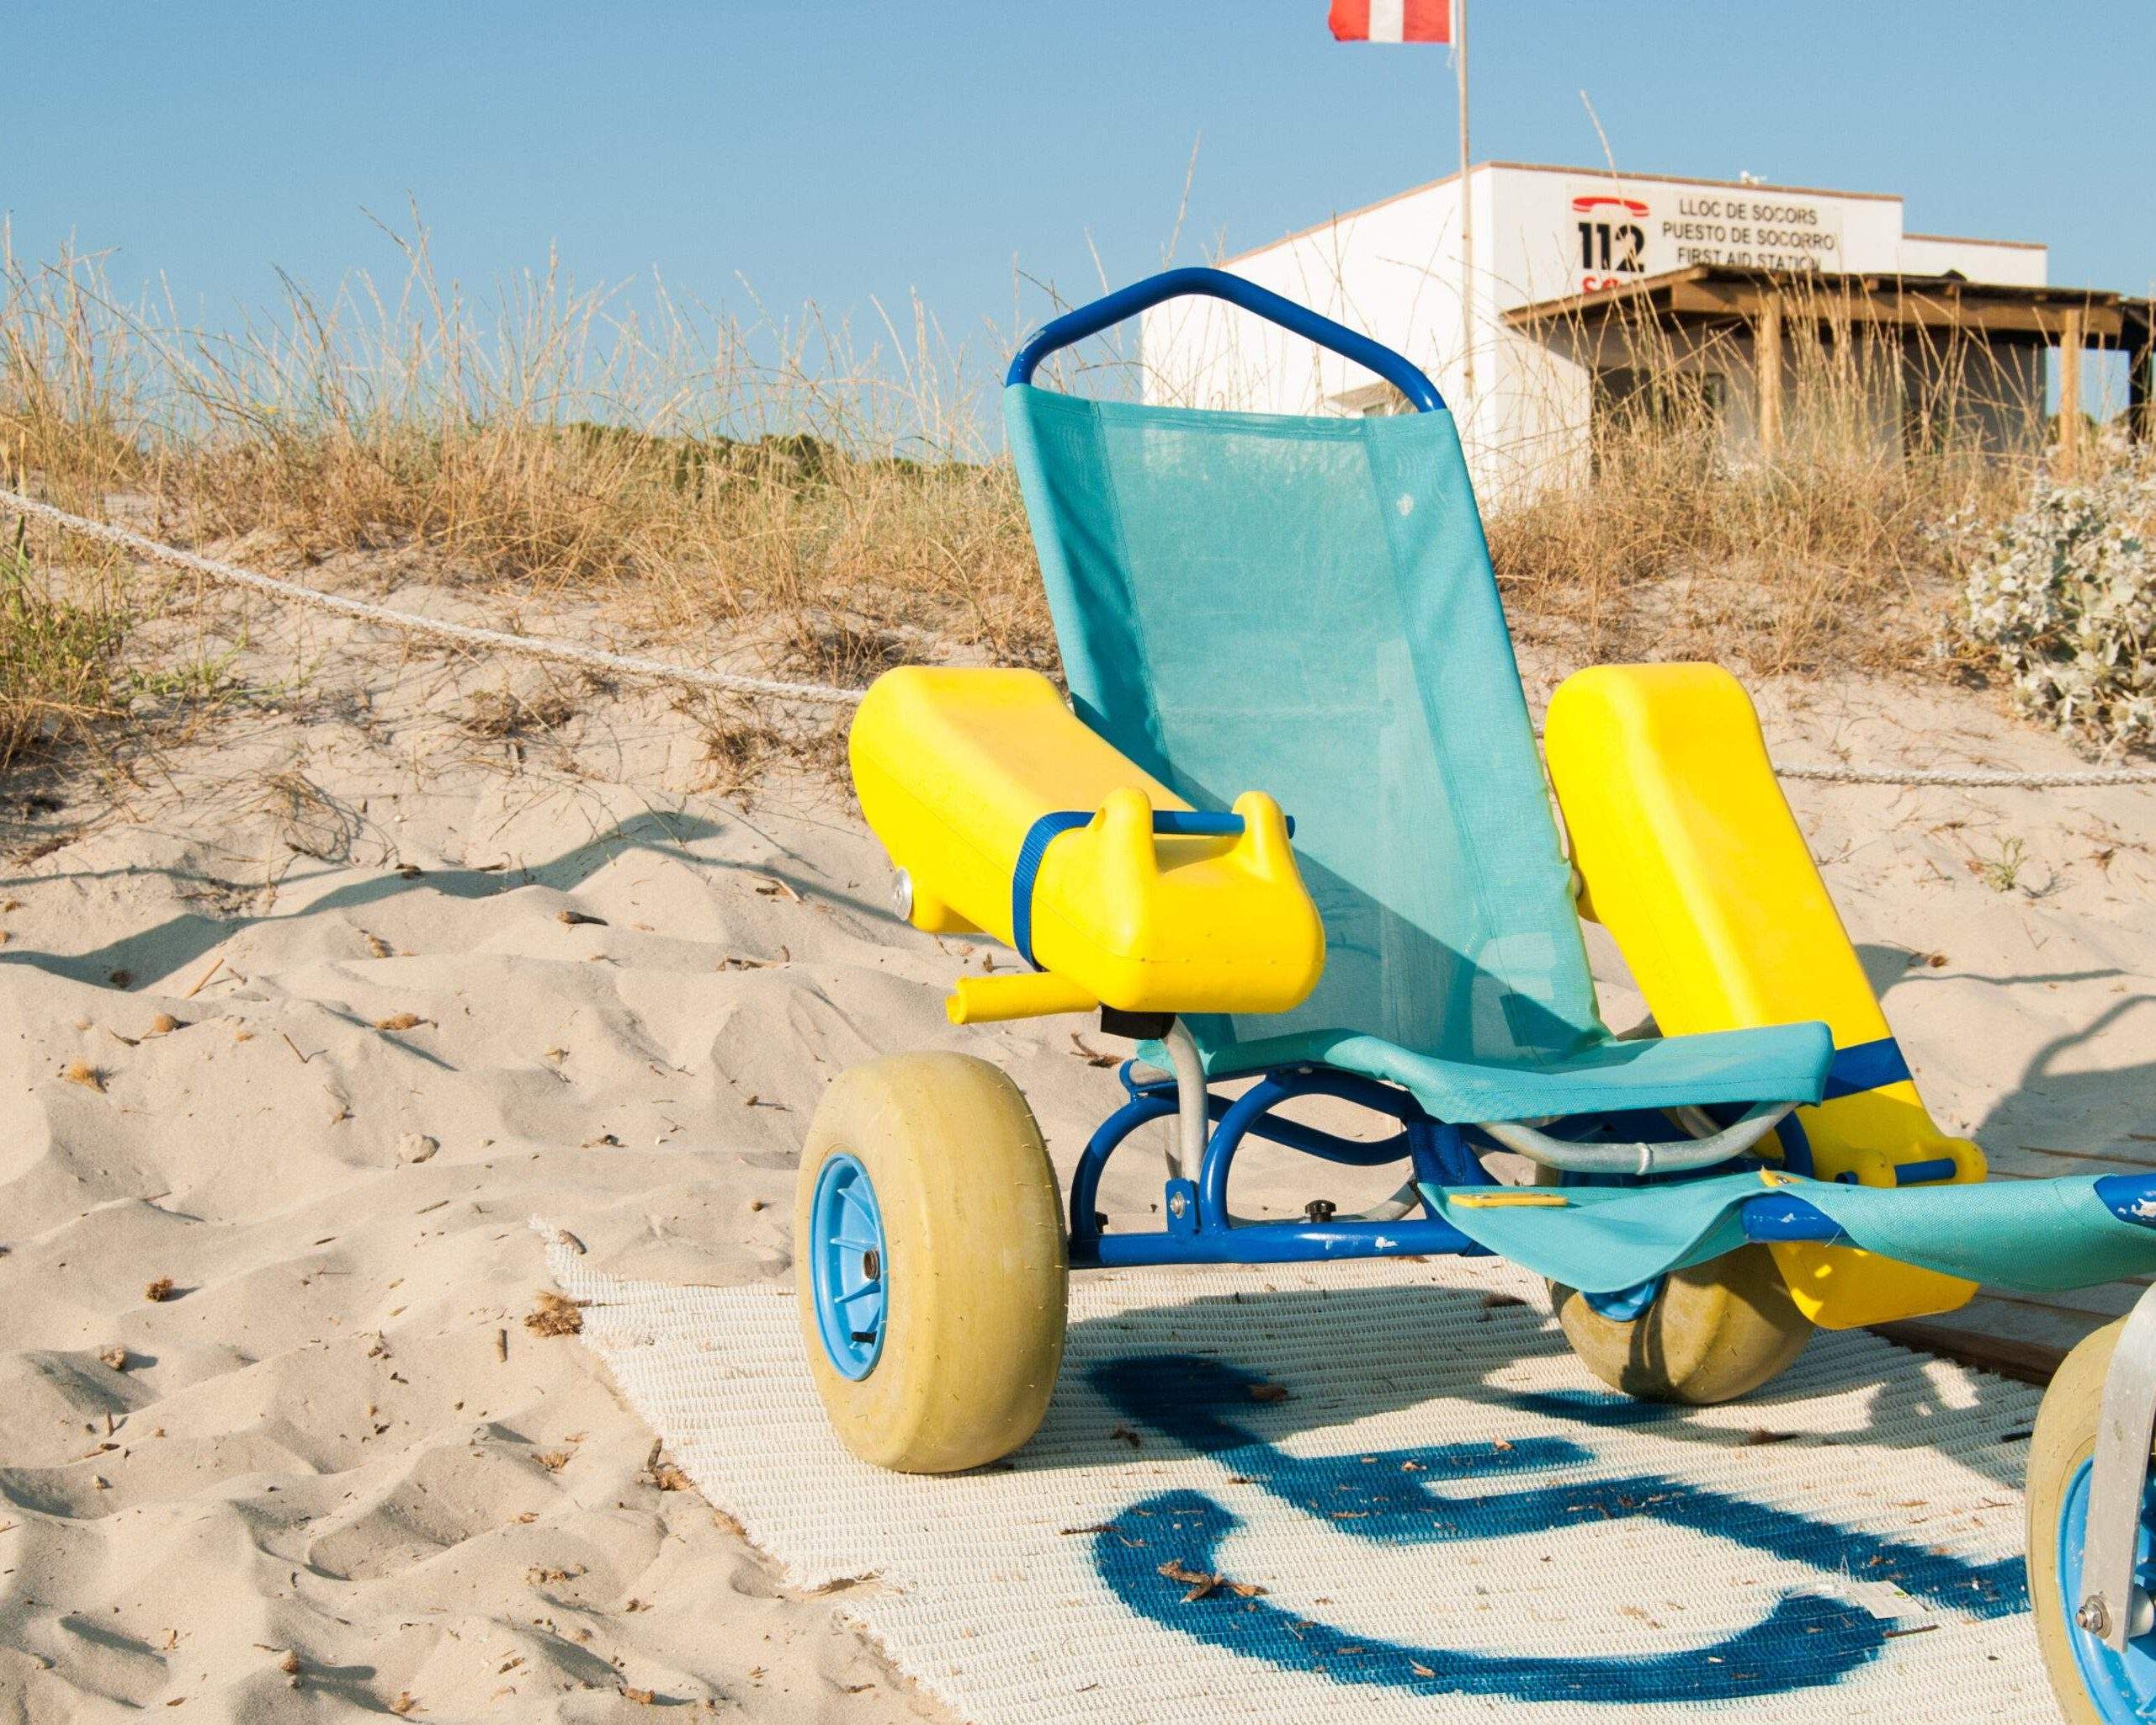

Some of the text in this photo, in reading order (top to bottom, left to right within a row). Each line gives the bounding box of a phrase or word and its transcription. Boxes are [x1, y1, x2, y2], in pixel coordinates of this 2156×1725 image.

[1680, 199, 1818, 226] LLOC DE SOCORS
[1578, 222, 1645, 273] 112
[1663, 221, 1835, 252] PUESTO DE SOCORRO
[1677, 247, 1721, 267] FIRST
[1727, 251, 1752, 268] AID
